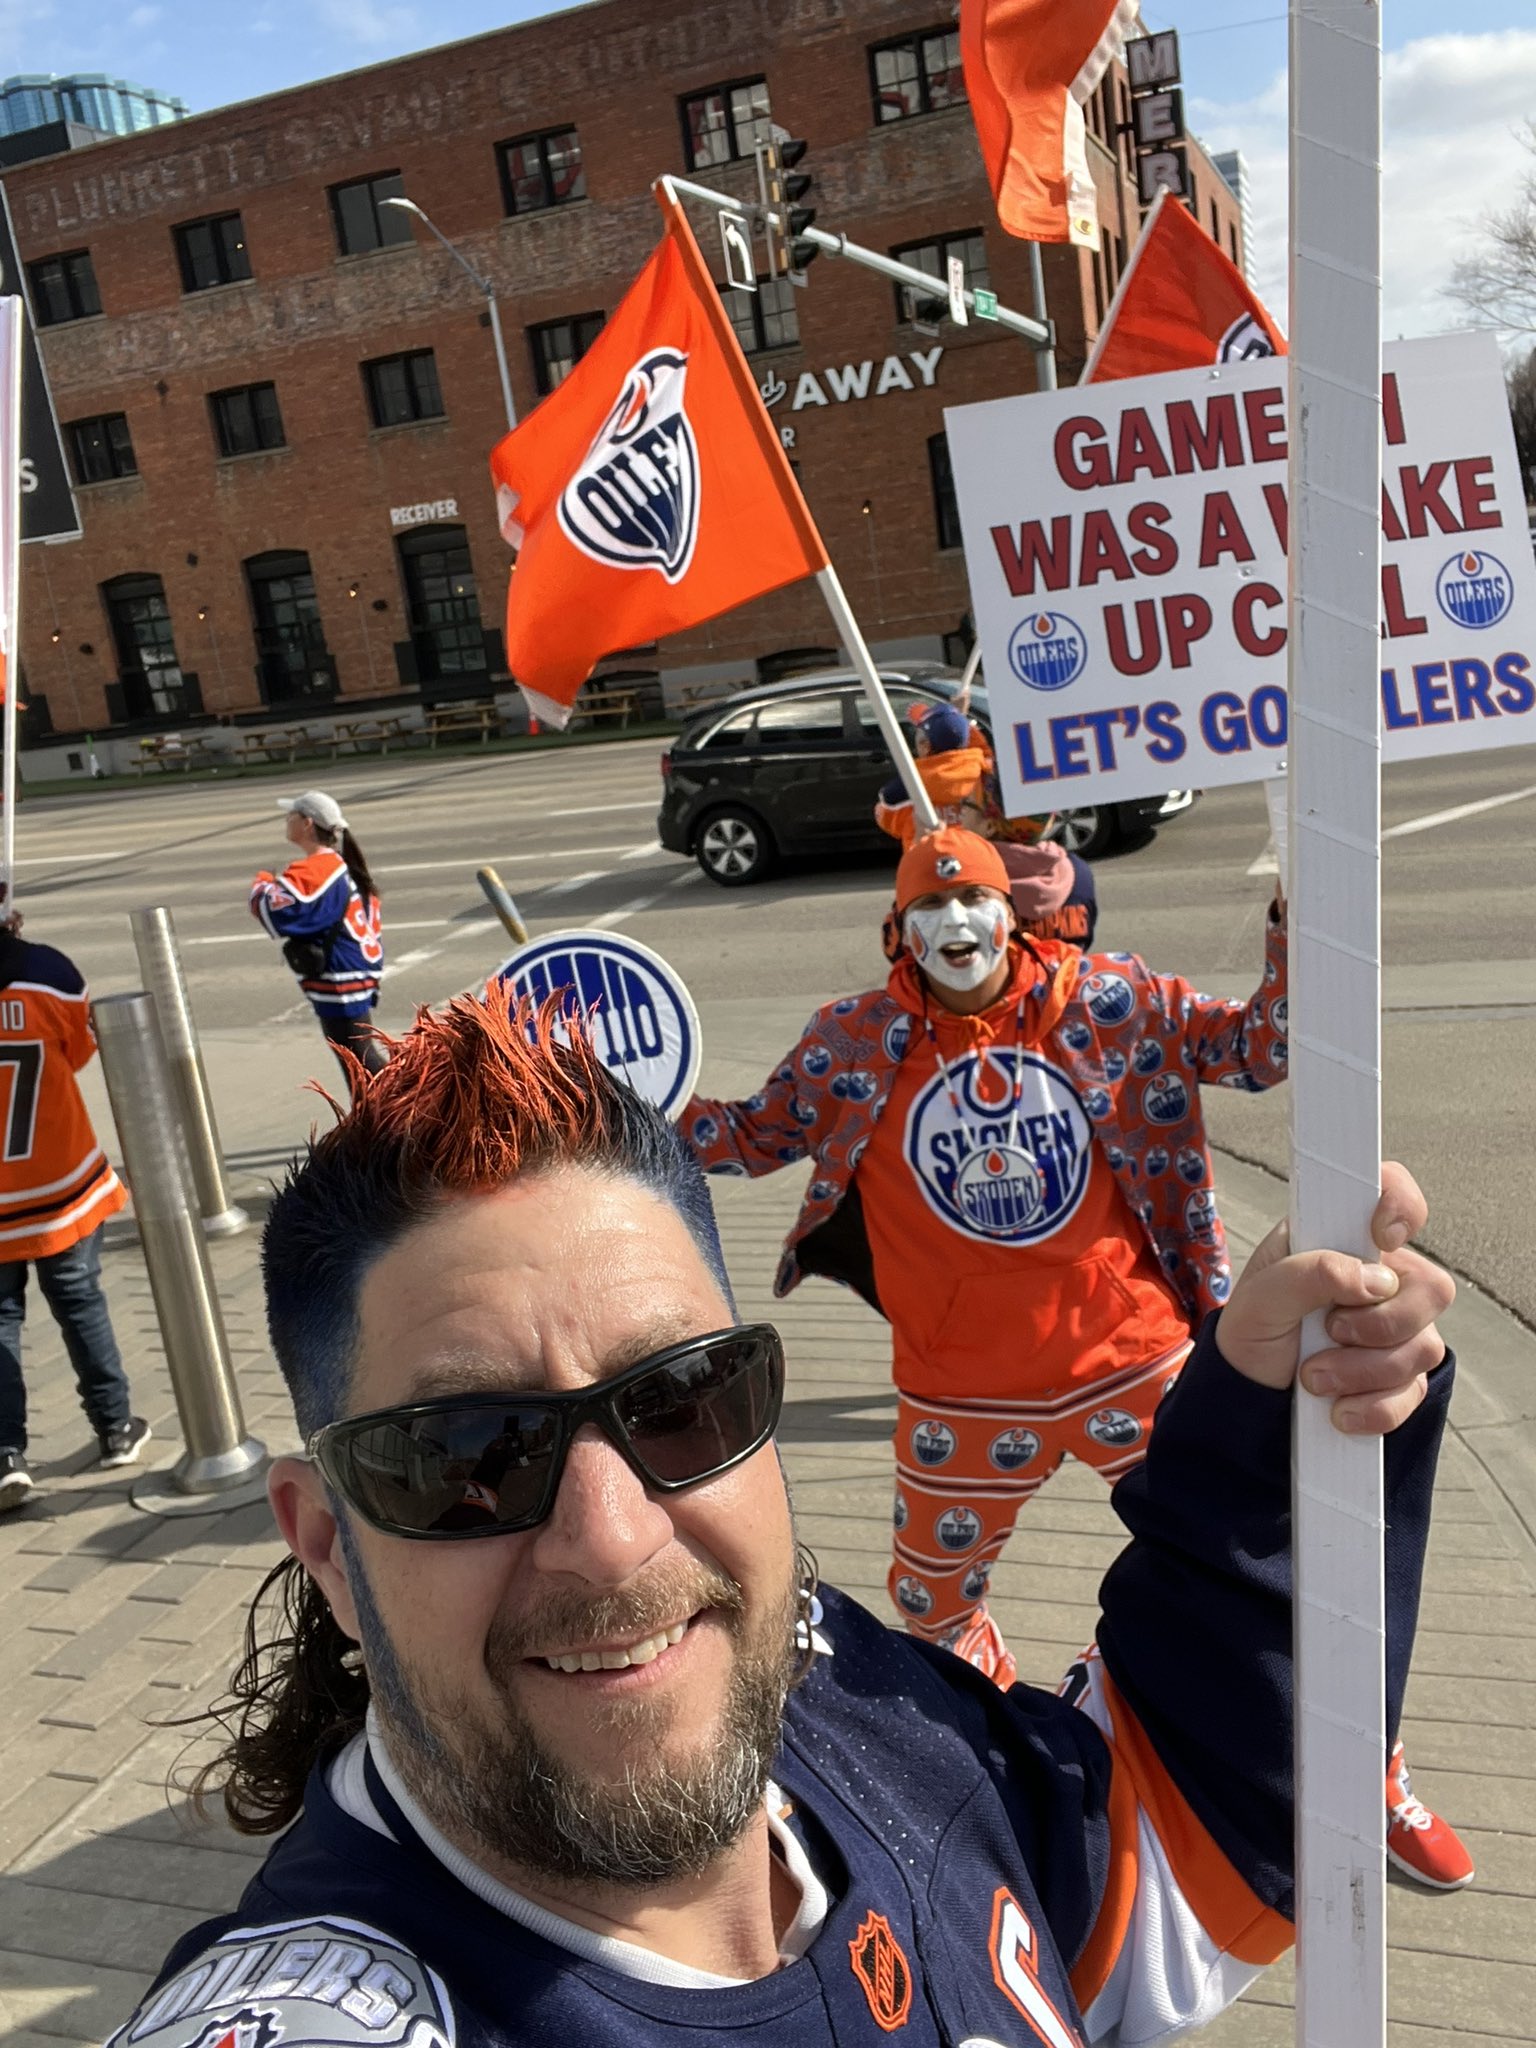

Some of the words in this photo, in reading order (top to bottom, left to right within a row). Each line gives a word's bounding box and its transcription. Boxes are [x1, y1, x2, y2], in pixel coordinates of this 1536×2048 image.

[791, 346, 944, 411] AWAY
[1054, 386, 1288, 492] GAME
[390, 499, 459, 526] RECEIVER
[990, 502, 1179, 598] WAS
[1199, 491, 1257, 568] A
[1444, 576, 1506, 610] OILERS
[1017, 636, 1079, 671] OILERS
[1103, 593, 1213, 676] UP
[1012, 700, 1188, 785] LET'S
[1199, 684, 1288, 756] GO
[1381, 651, 1536, 732] LERS
[964, 1176, 1035, 1210] SKODEN
[127, 1938, 418, 2031] OILERS
